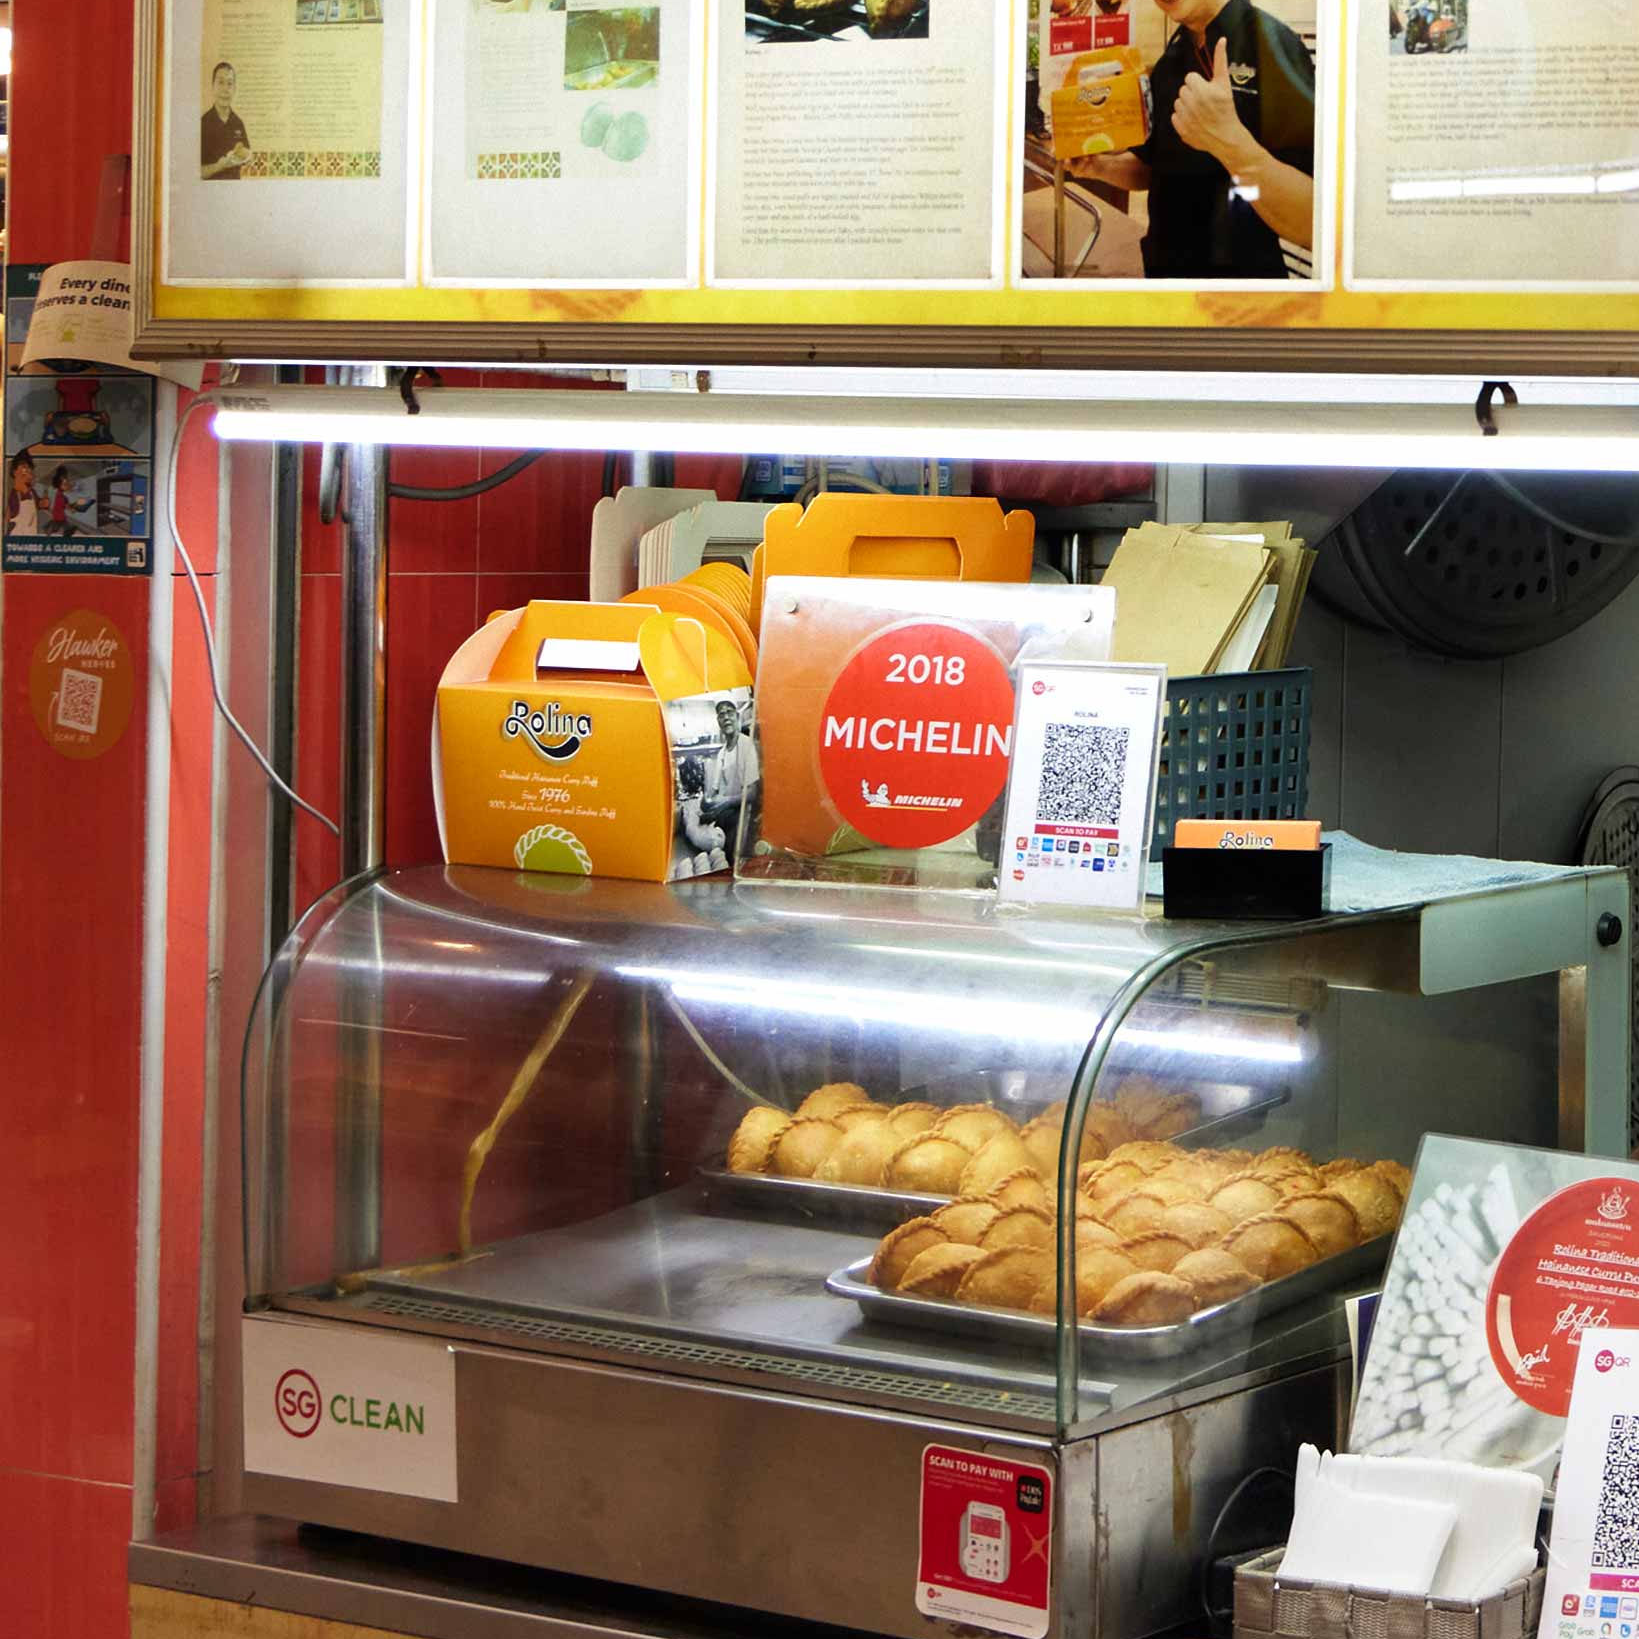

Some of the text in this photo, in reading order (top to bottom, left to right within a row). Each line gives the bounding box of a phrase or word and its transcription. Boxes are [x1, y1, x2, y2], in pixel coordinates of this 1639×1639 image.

[60, 278, 97, 292] Every
[79, 295, 88, 306] a
[47, 626, 119, 664] Hawker
[885, 653, 966, 686] 2018
[501, 700, 592, 764] Rolina
[824, 715, 1013, 757] MICHELIN
[539, 787, 570, 803] 1976
[893, 794, 964, 808] MICHELIN
[1055, 827, 1074, 836] SCAN
[1075, 828, 1083, 837] TO
[1219, 831, 1274, 850] Rolina
[1553, 1243, 1588, 1258] Rolina
[1538, 1258, 1590, 1275] Hainanese
[1591, 1265, 1622, 1280] Curry
[1614, 1357, 1631, 1367] QR
[281, 1384, 425, 1436] SG CLEAN
[928, 1455, 955, 1470] SCAN
[956, 1460, 968, 1472] TO
[969, 1462, 987, 1476] PAY
[989, 1467, 1014, 1482] WITH
